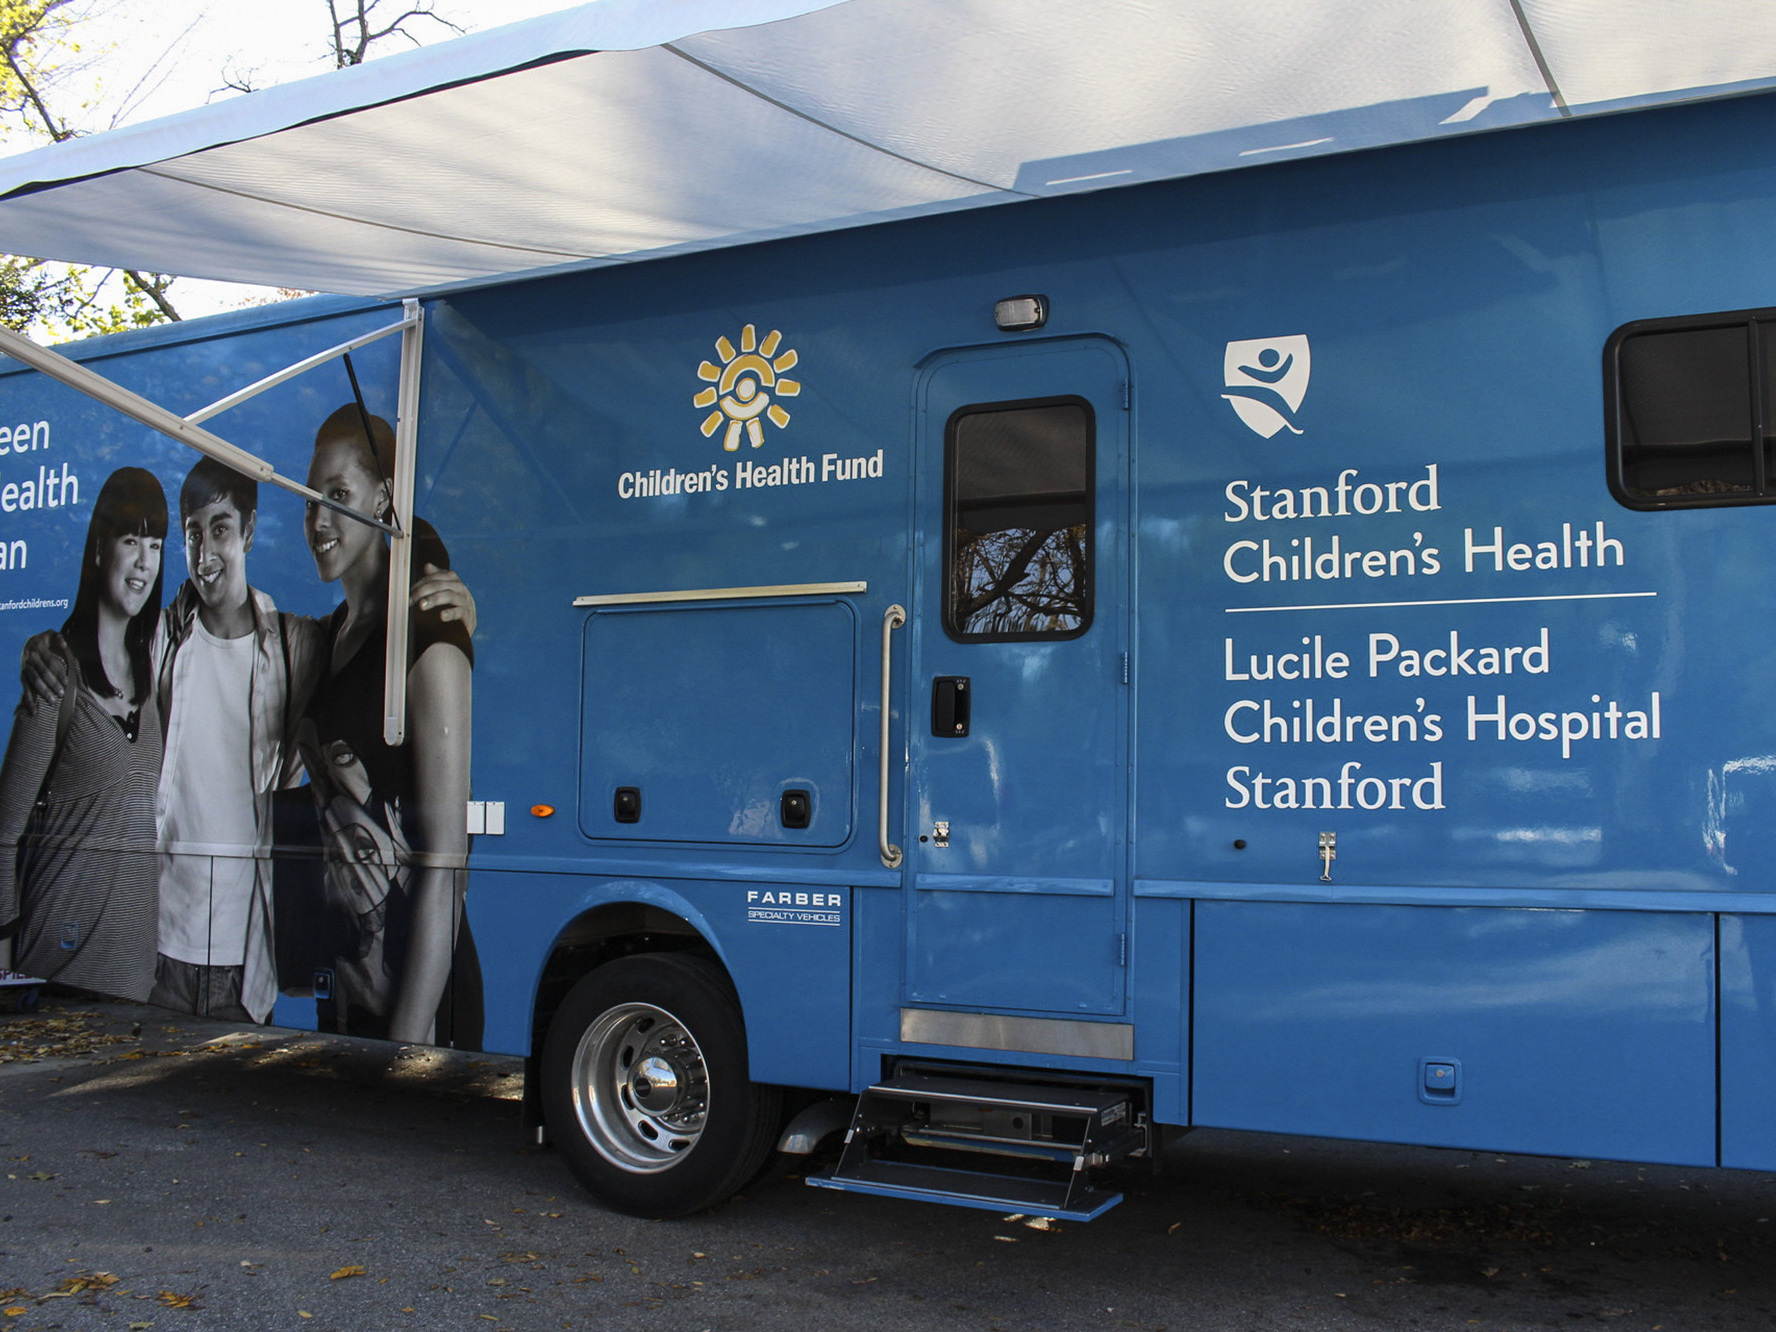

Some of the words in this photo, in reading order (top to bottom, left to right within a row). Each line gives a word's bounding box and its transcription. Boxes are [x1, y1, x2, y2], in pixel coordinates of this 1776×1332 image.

[0, 462, 79, 512] ealth
[618, 464, 729, 499] Children's
[735, 455, 815, 489] Health
[821, 449, 884, 482] Fund
[1224, 463, 1442, 522] Stanford
[1223, 531, 1441, 583] Children's
[1464, 521, 1625, 573] Health
[1225, 635, 1350, 681] Lucile
[1369, 627, 1549, 678] Packard
[1224, 697, 1443, 744] Children's
[1467, 691, 1661, 759] Hospital
[1225, 761, 1446, 810] Stanford
[747, 890, 841, 907] FARBER
[748, 910, 795, 920] SPECIALTY
[796, 912, 840, 923] VEHICLES
